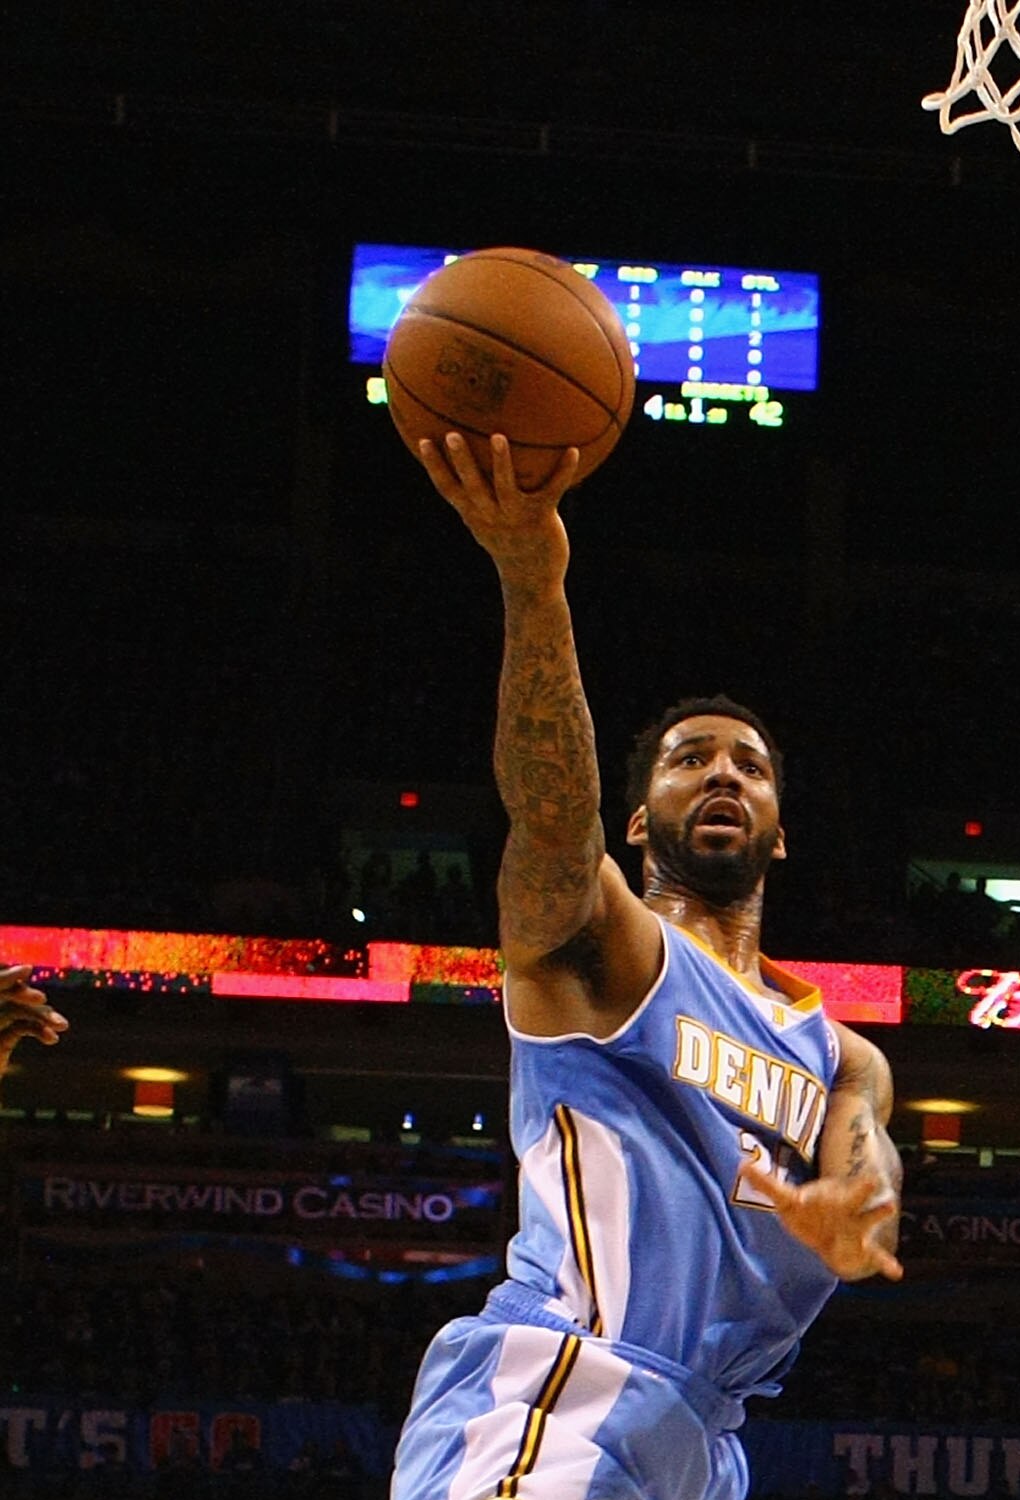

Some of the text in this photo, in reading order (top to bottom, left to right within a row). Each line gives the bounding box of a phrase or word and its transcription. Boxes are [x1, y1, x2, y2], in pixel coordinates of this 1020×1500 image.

[673, 1014, 828, 1164] DENV
[295, 1185, 455, 1223] CASINO
[730, 1129, 790, 1213] 2
